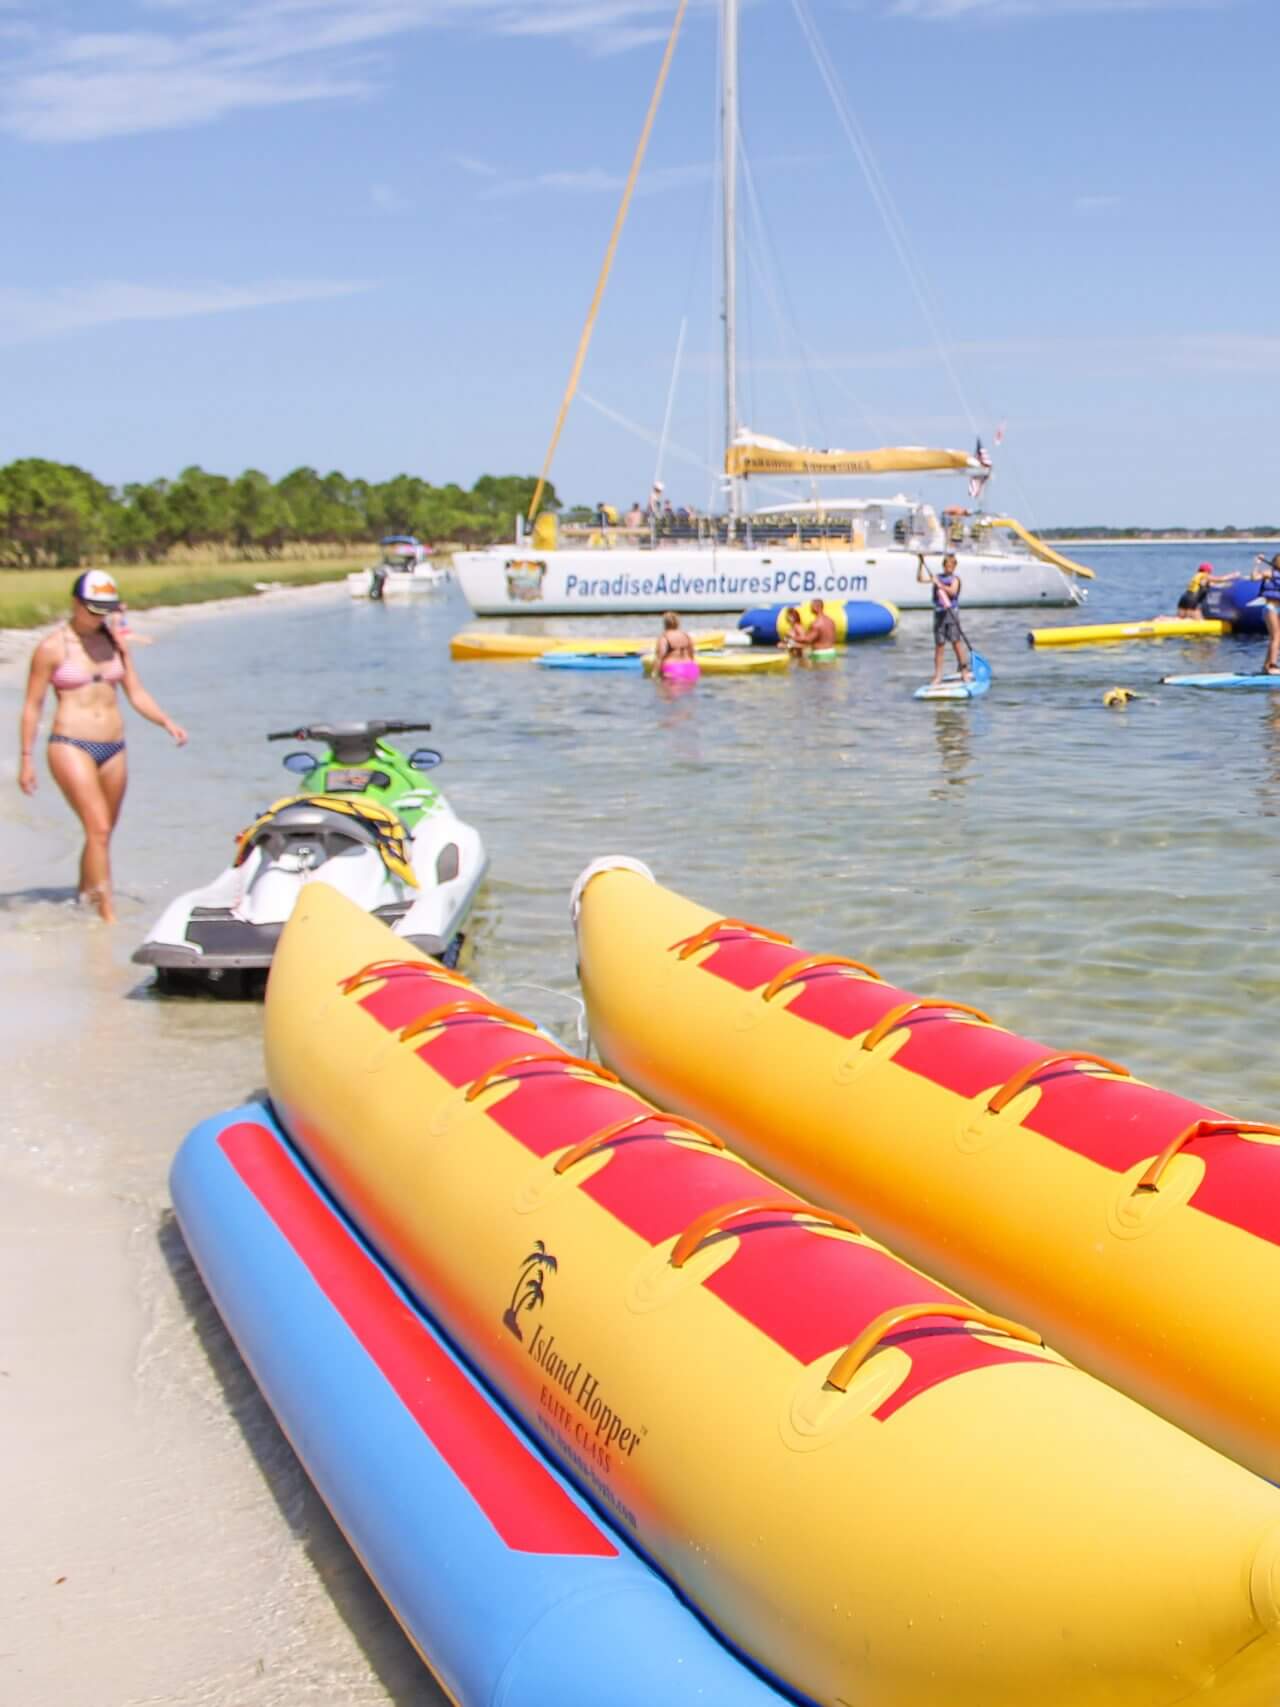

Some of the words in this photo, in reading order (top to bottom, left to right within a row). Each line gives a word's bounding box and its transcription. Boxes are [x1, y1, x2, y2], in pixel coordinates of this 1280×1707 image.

[566, 572, 868, 597] ParadiseAdventuresPCB.com
[528, 1323, 582, 1395] Island
[576, 1373, 640, 1457] Hopper
[540, 1384, 572, 1433] ELITE
[575, 1423, 611, 1473] CLASS
